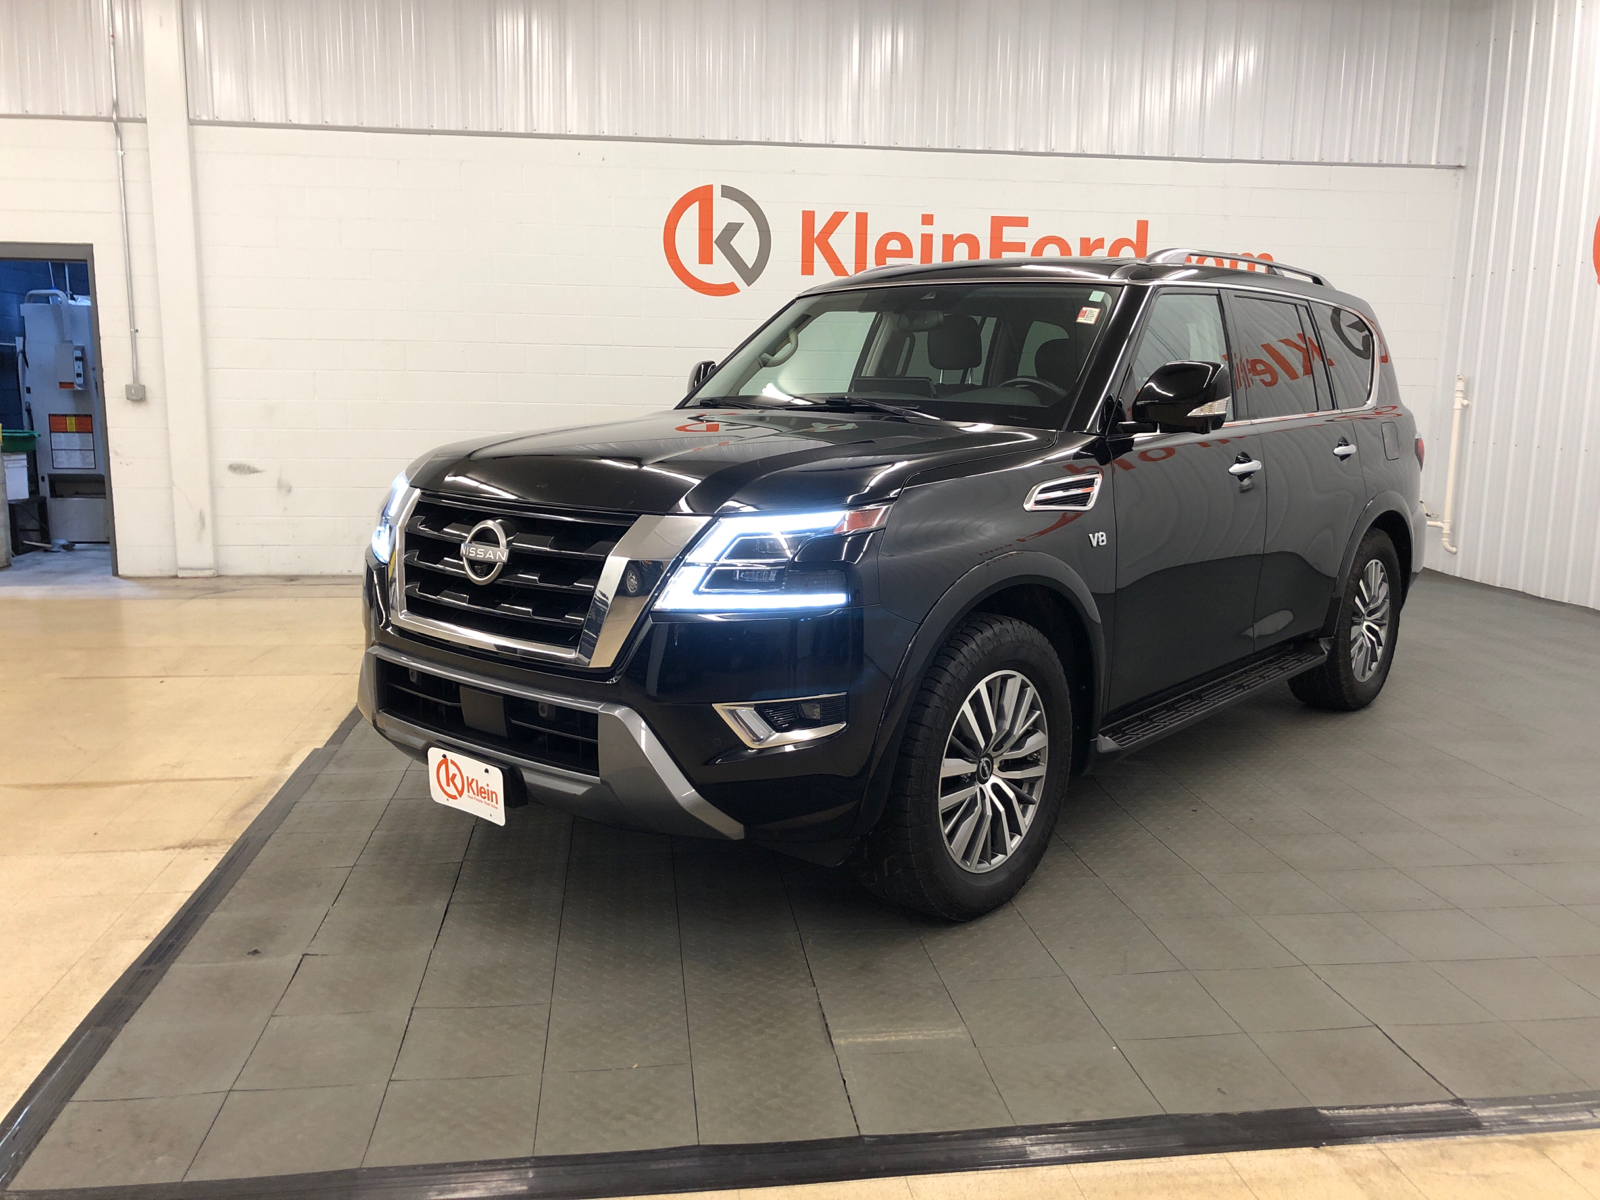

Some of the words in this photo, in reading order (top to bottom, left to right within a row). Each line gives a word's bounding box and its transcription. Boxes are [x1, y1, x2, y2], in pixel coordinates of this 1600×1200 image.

[1088, 531, 1107, 548] V8
[460, 545, 507, 561] NISSAN
[466, 775, 499, 805] Klein
